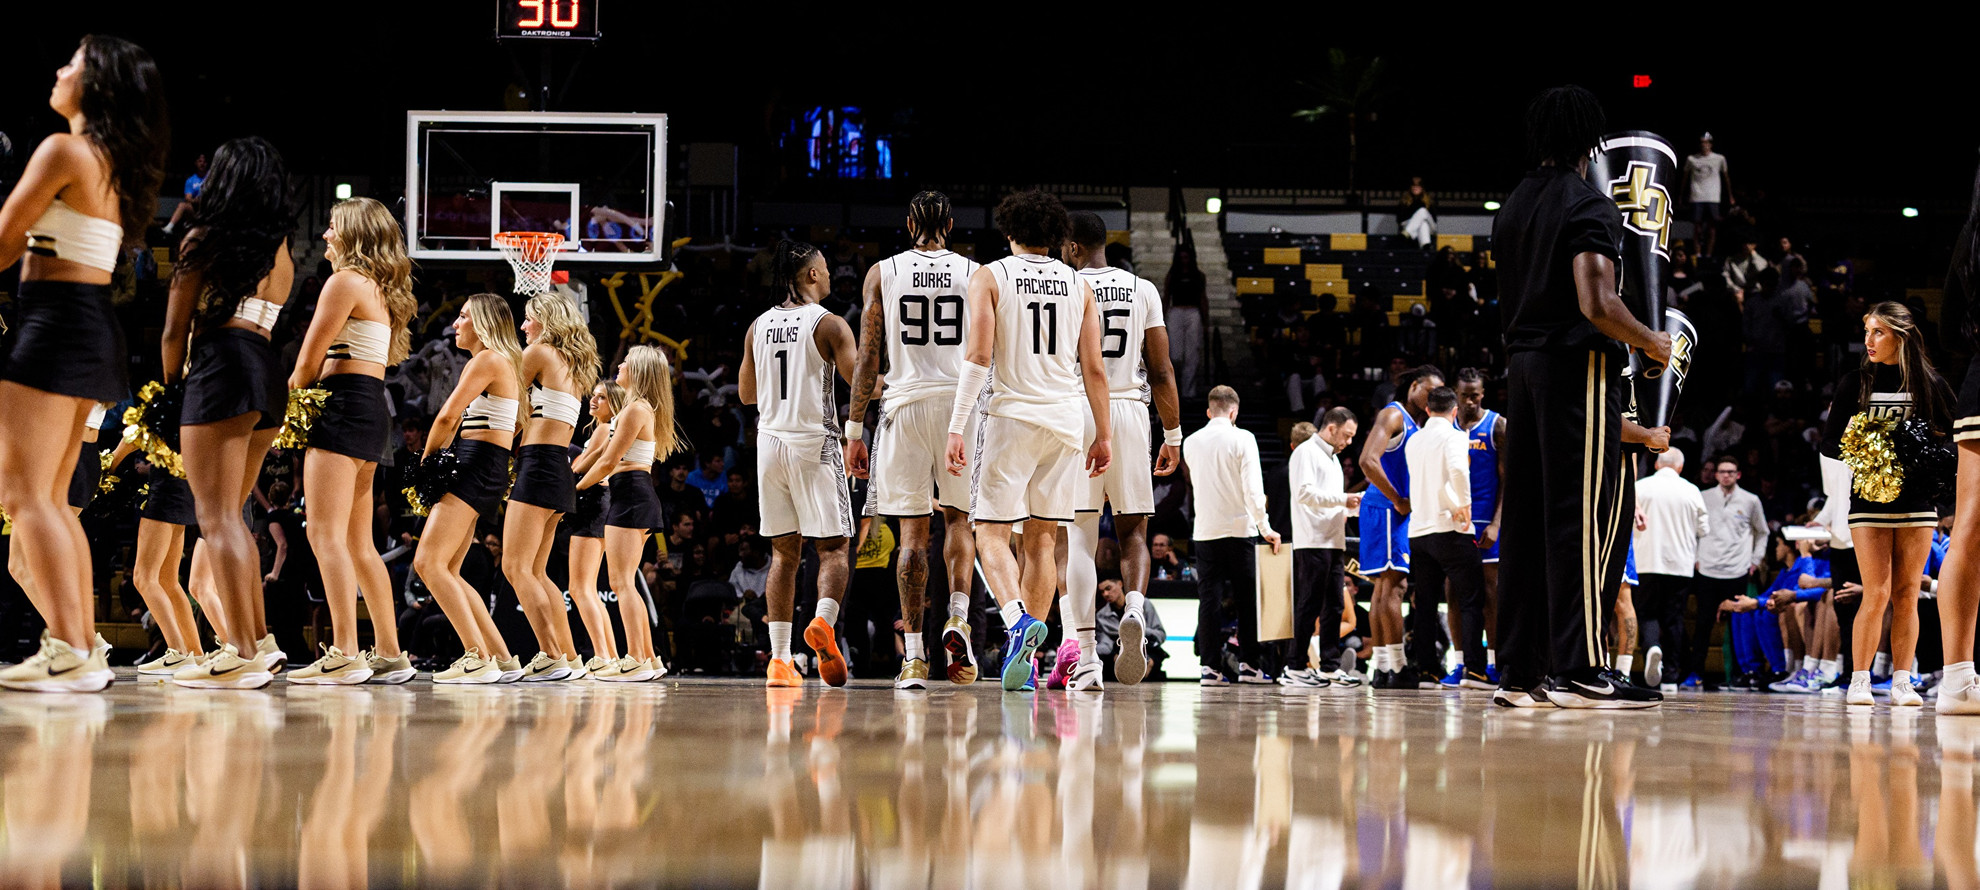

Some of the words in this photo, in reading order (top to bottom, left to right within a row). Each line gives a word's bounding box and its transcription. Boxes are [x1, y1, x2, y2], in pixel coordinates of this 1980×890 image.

[913, 272, 951, 288] BURKS
[1015, 278, 1069, 297] PACHECO
[766, 327, 799, 344] FULKS
[899, 295, 964, 345] 99
[1027, 302, 1057, 355] 11
[774, 350, 788, 400] 1
